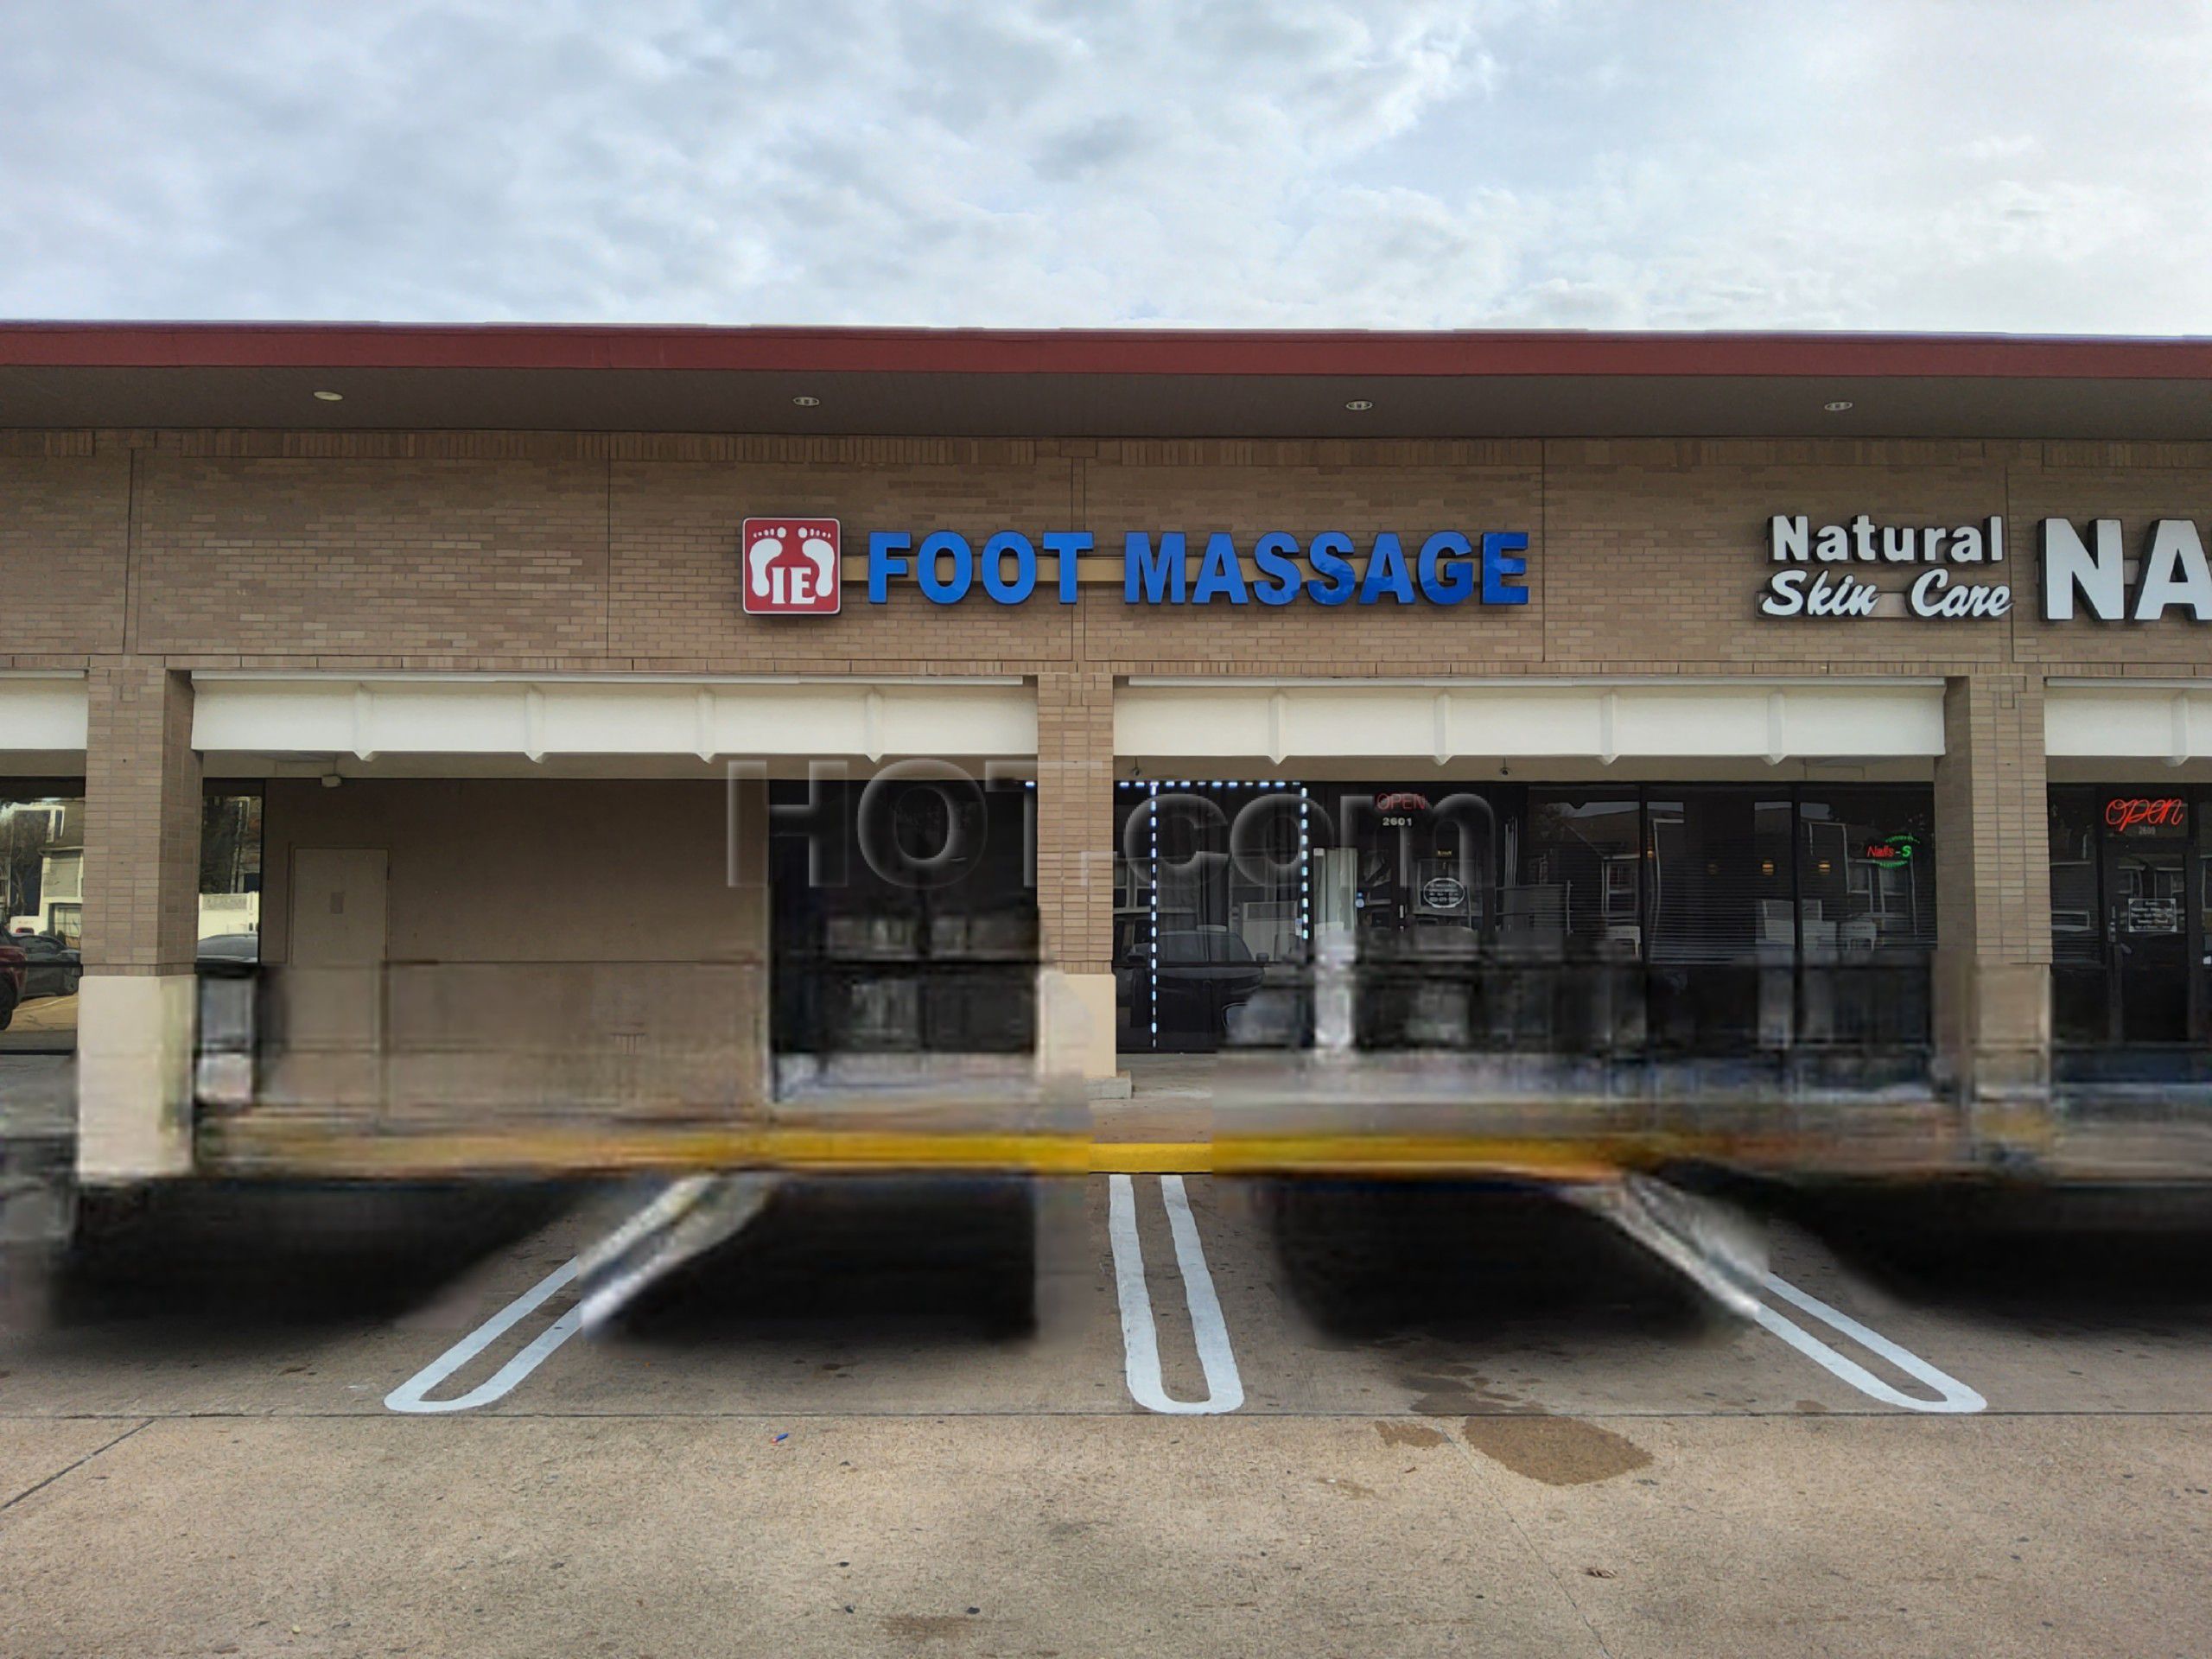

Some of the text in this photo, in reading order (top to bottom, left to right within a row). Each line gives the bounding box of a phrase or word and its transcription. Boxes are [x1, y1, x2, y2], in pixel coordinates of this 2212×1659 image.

[1770, 515, 2004, 563] Natural
[772, 567, 816, 605] IE
[868, 531, 1529, 606] FOOT MASSAGE
[1762, 569, 2013, 617] Skin Care
[1376, 793, 1426, 810] OPEN
[1382, 817, 1413, 827] 2601
